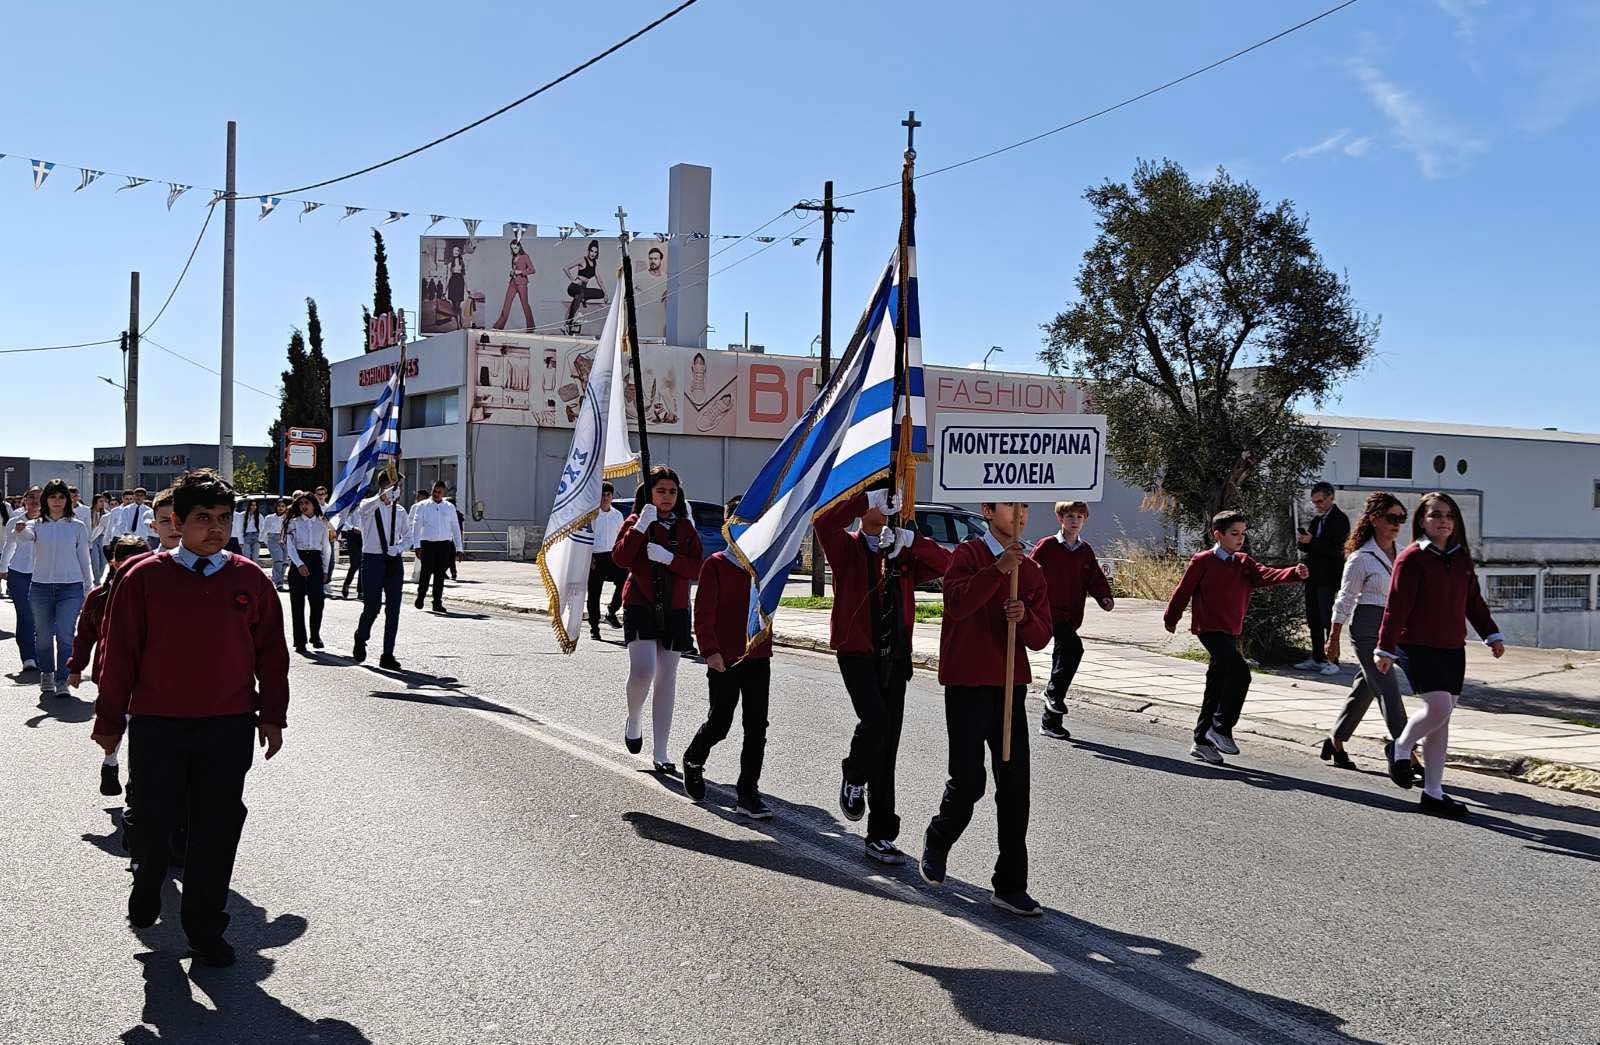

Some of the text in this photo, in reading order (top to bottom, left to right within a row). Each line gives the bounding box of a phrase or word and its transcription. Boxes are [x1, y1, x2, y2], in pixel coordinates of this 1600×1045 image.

[359, 364, 389, 386] FASHION
[937, 377, 1064, 410] FASHION
[949, 432, 1091, 455] ΜΟΝΤΕΣΣΟΡΙΑΝΑ
[983, 462, 1055, 484] ΣΧΟΛΕΙΑ
